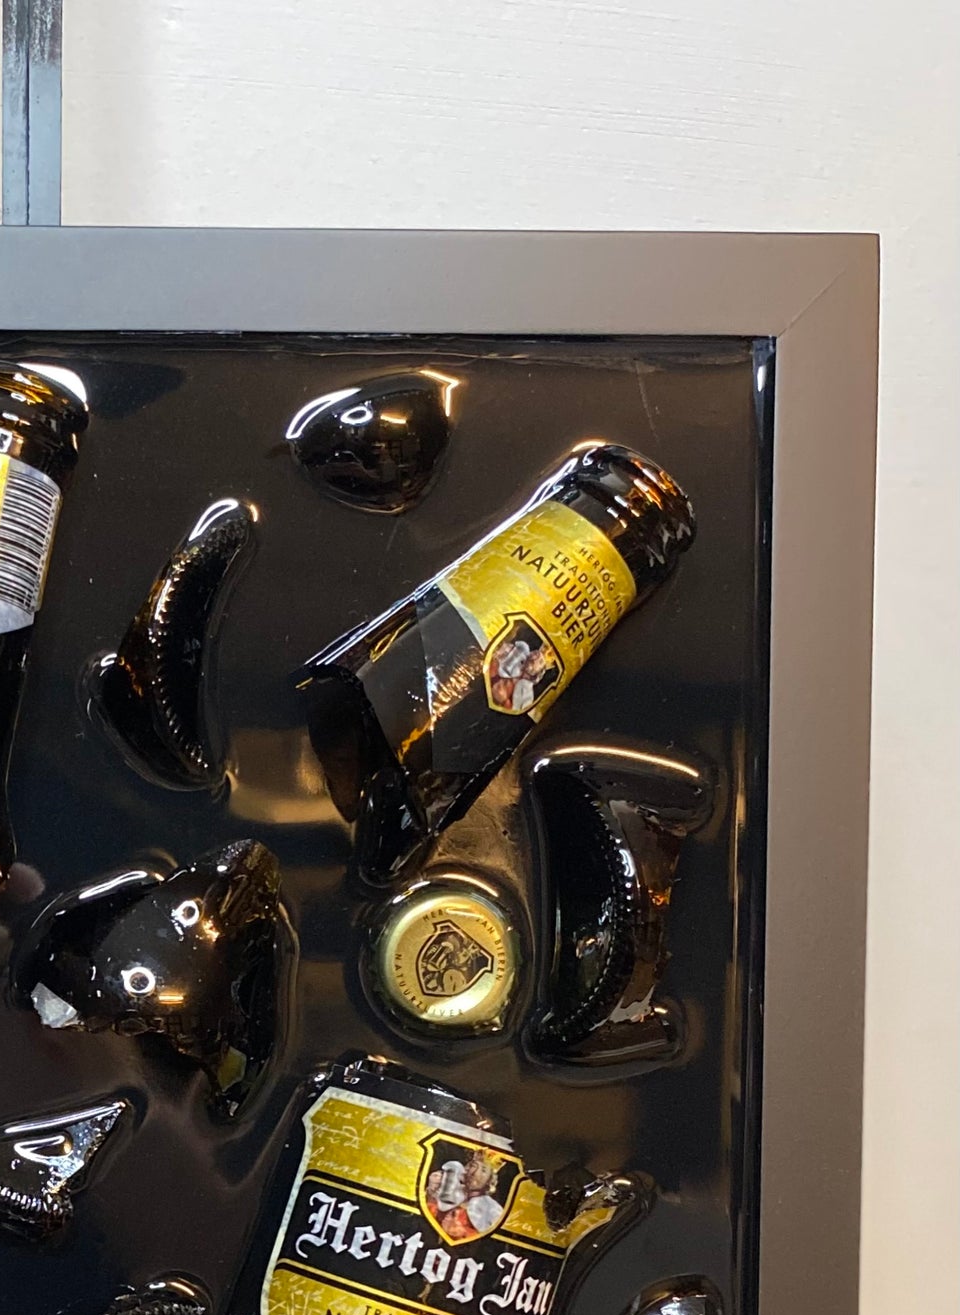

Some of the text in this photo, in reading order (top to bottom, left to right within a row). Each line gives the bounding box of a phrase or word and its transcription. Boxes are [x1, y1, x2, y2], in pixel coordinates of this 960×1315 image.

[510, 545, 603, 645] NATUURZUI
[554, 551, 608, 625] TRADITION
[578, 547, 616, 592] HERTOG
[551, 601, 585, 649] BIER
[295, 1191, 484, 1304] Hertog
